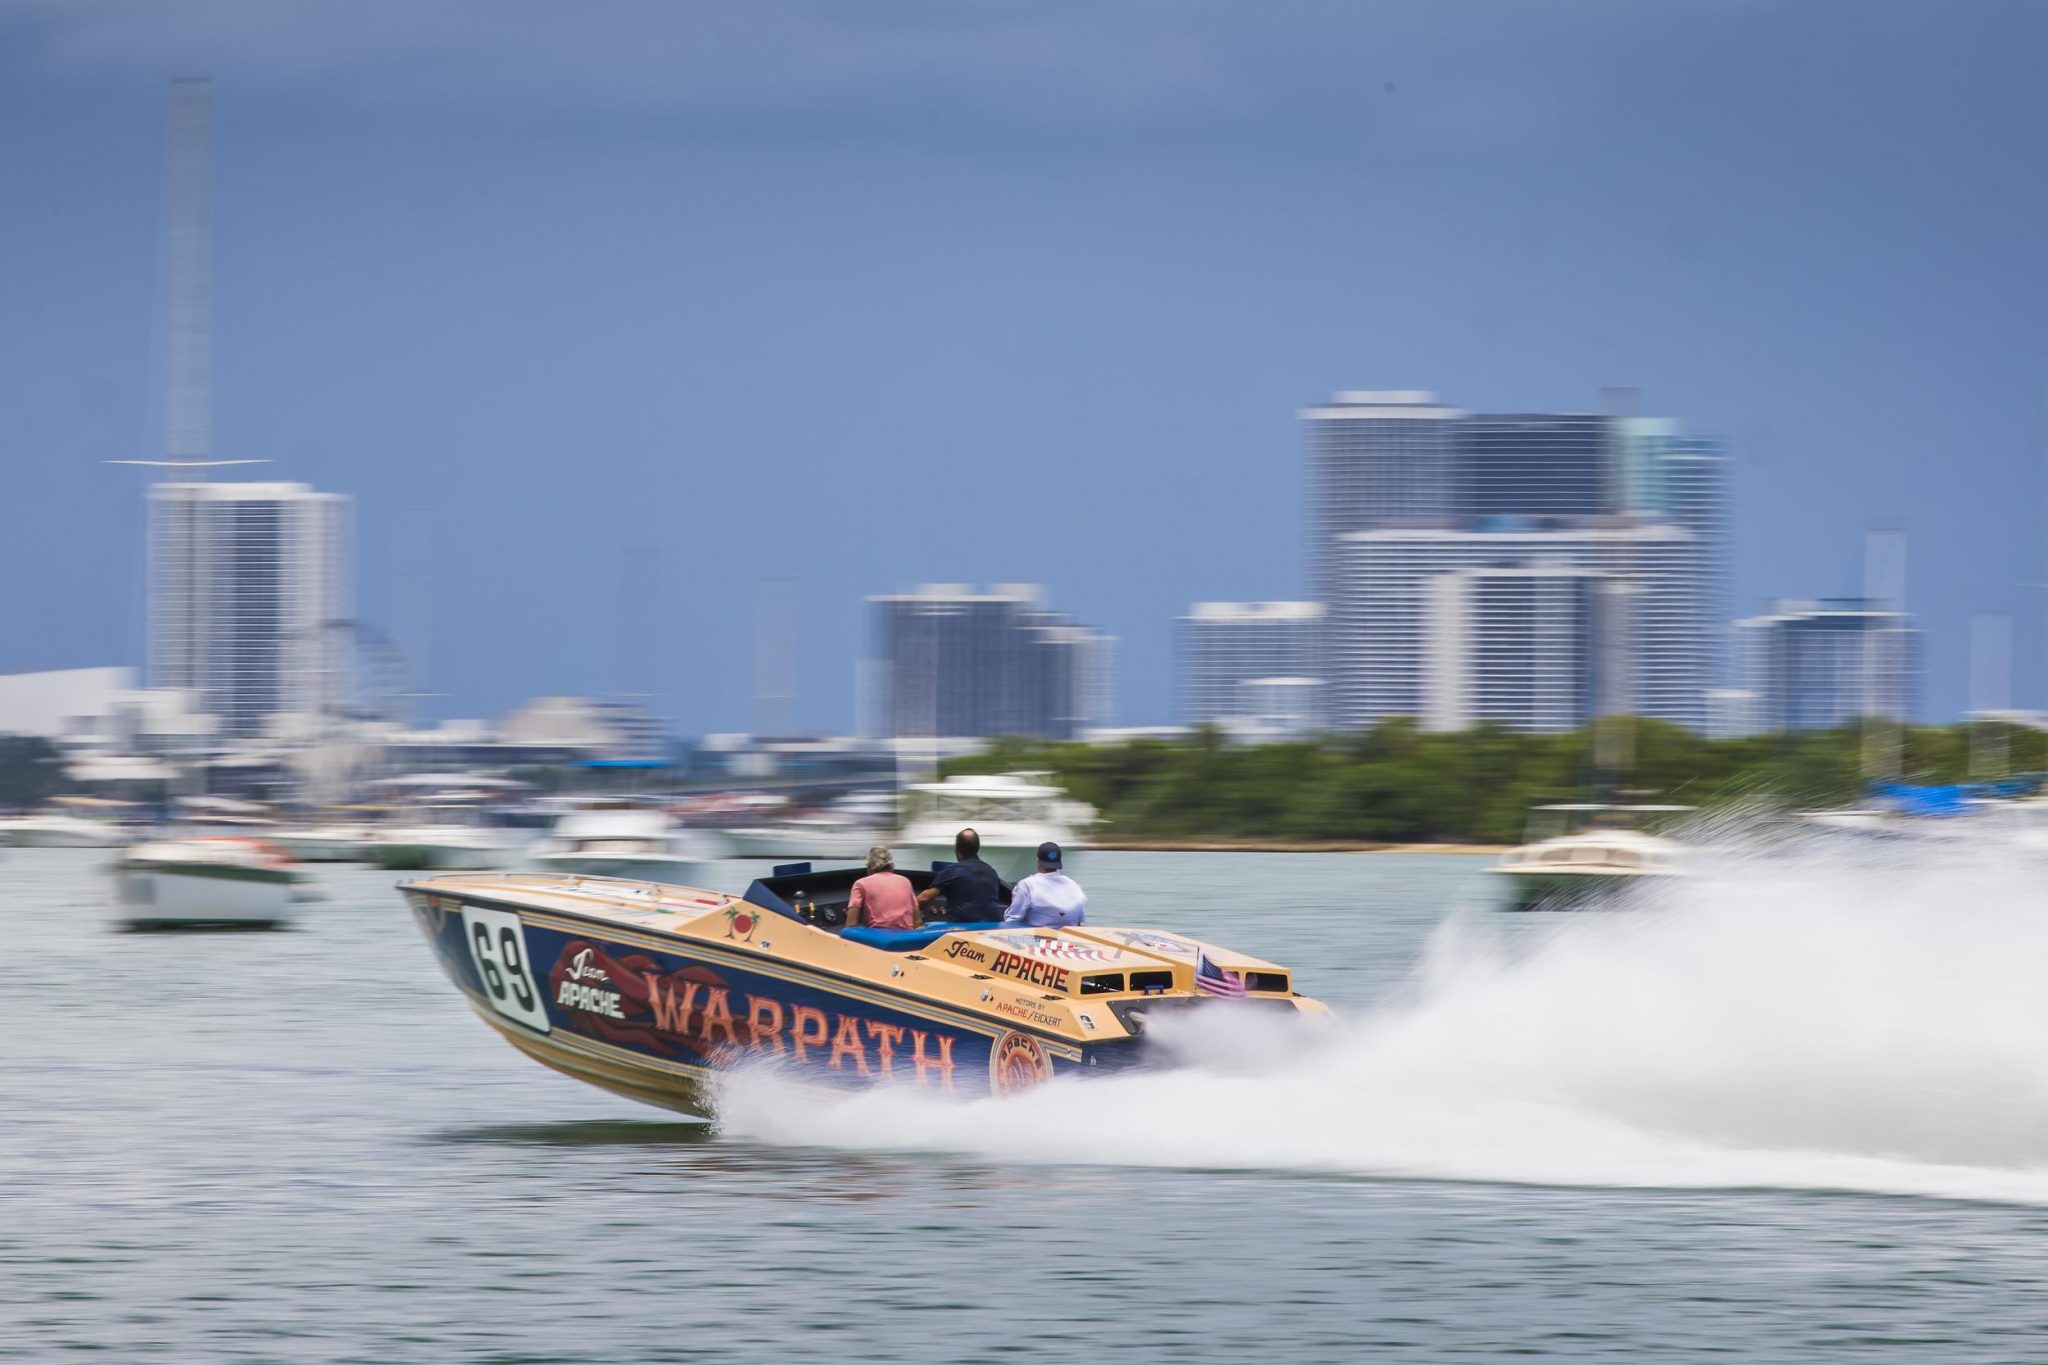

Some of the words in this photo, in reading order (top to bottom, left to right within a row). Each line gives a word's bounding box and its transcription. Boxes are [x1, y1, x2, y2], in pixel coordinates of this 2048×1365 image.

[472, 921, 535, 1013] 69
[565, 948, 610, 982] Team
[943, 940, 986, 964] Team
[990, 951, 1069, 992] APACHE
[557, 981, 626, 1019] APACHE
[642, 971, 957, 1089] WARPATH
